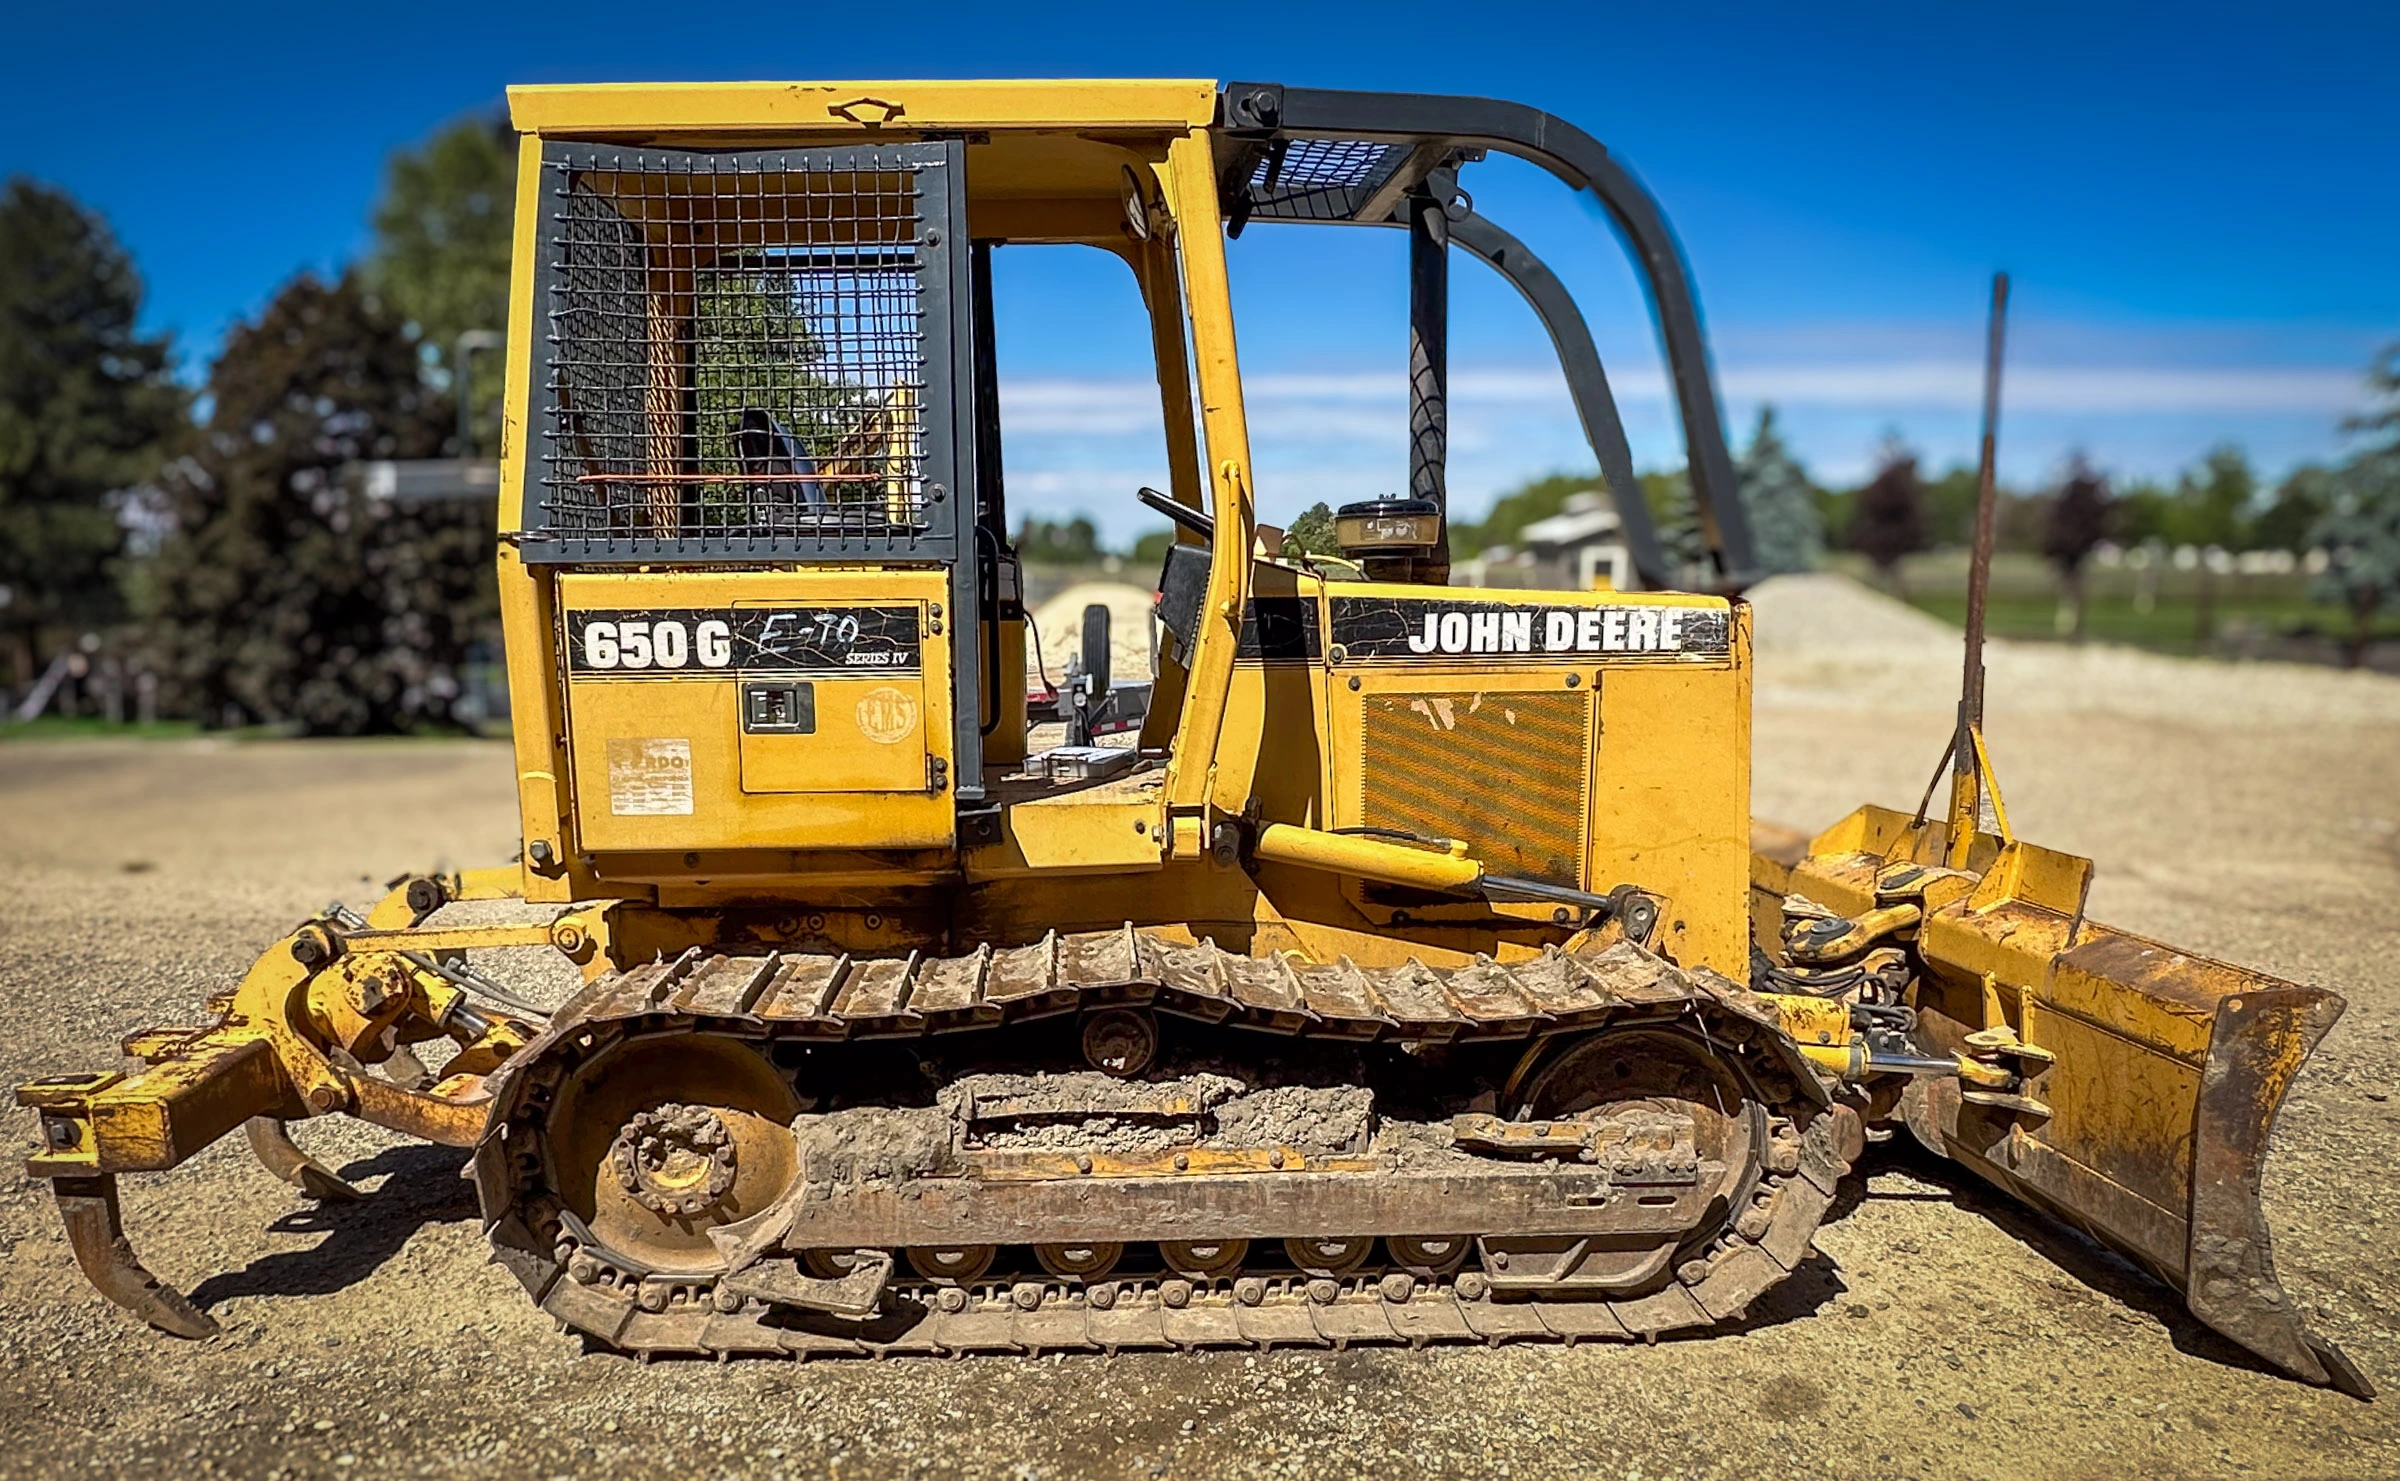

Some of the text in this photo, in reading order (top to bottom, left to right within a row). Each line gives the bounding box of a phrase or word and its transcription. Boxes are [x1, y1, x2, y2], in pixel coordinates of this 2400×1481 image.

[584, 620, 732, 669] 650 G
[1408, 610, 1683, 653] JOHN DEERE
[845, 652, 909, 664] SERIES IV
